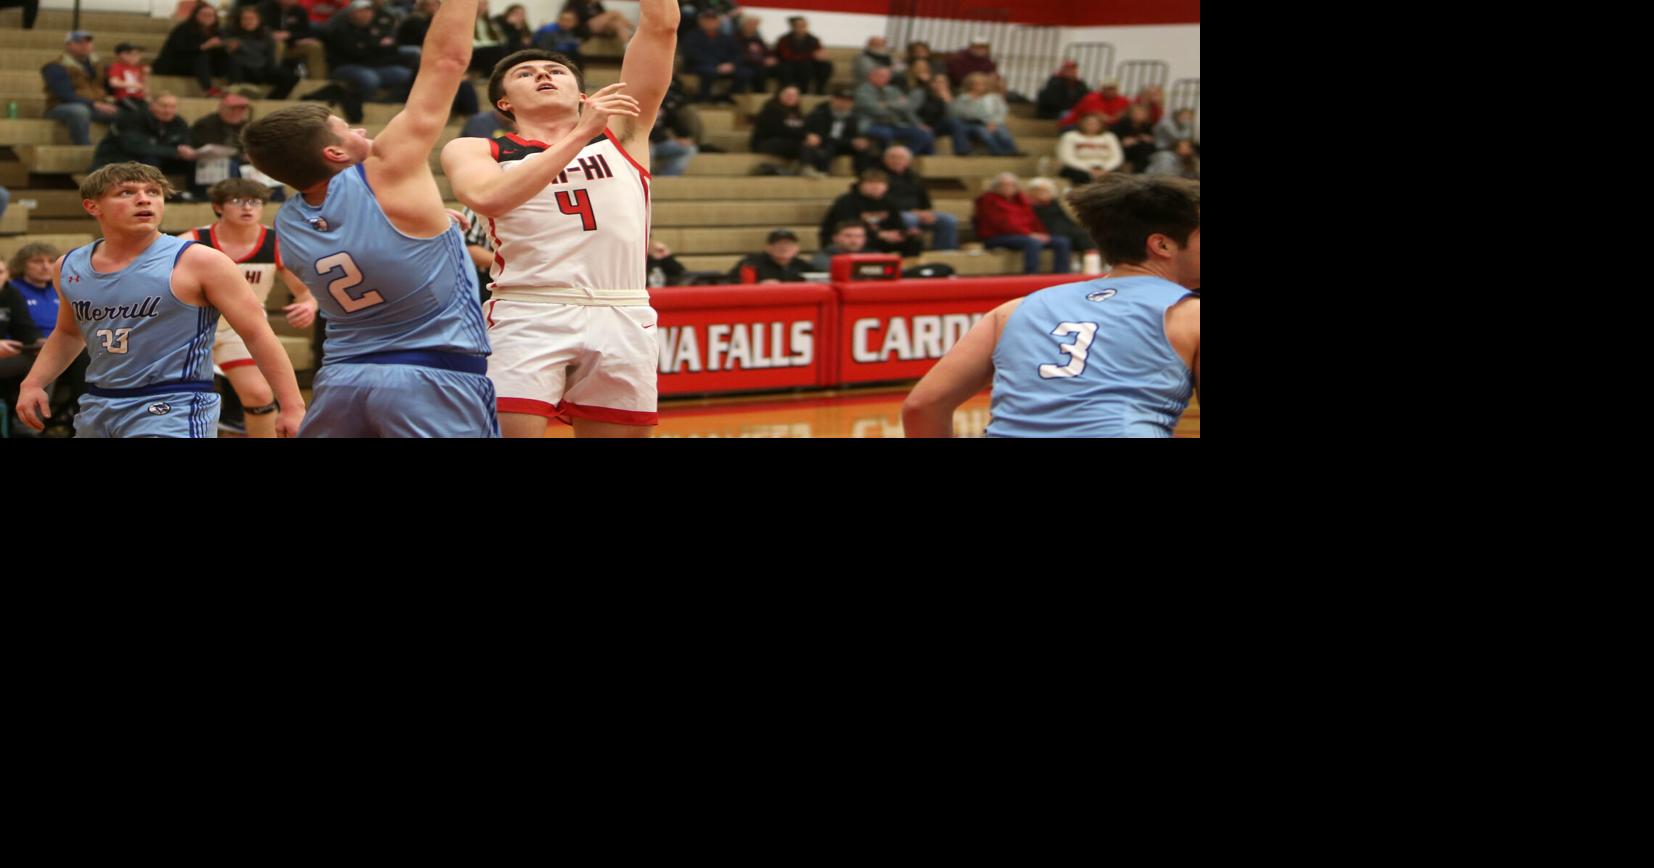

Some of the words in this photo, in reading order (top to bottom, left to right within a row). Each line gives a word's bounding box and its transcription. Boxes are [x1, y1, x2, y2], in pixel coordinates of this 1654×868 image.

[551, 153, 614, 184] I-HI
[554, 188, 597, 231] 4
[314, 251, 385, 314] 2
[71, 296, 161, 321] Merrill
[96, 327, 133, 354] 33
[707, 320, 814, 371] FALLS
[852, 312, 985, 362] CARD
[1038, 321, 1099, 379] 3
